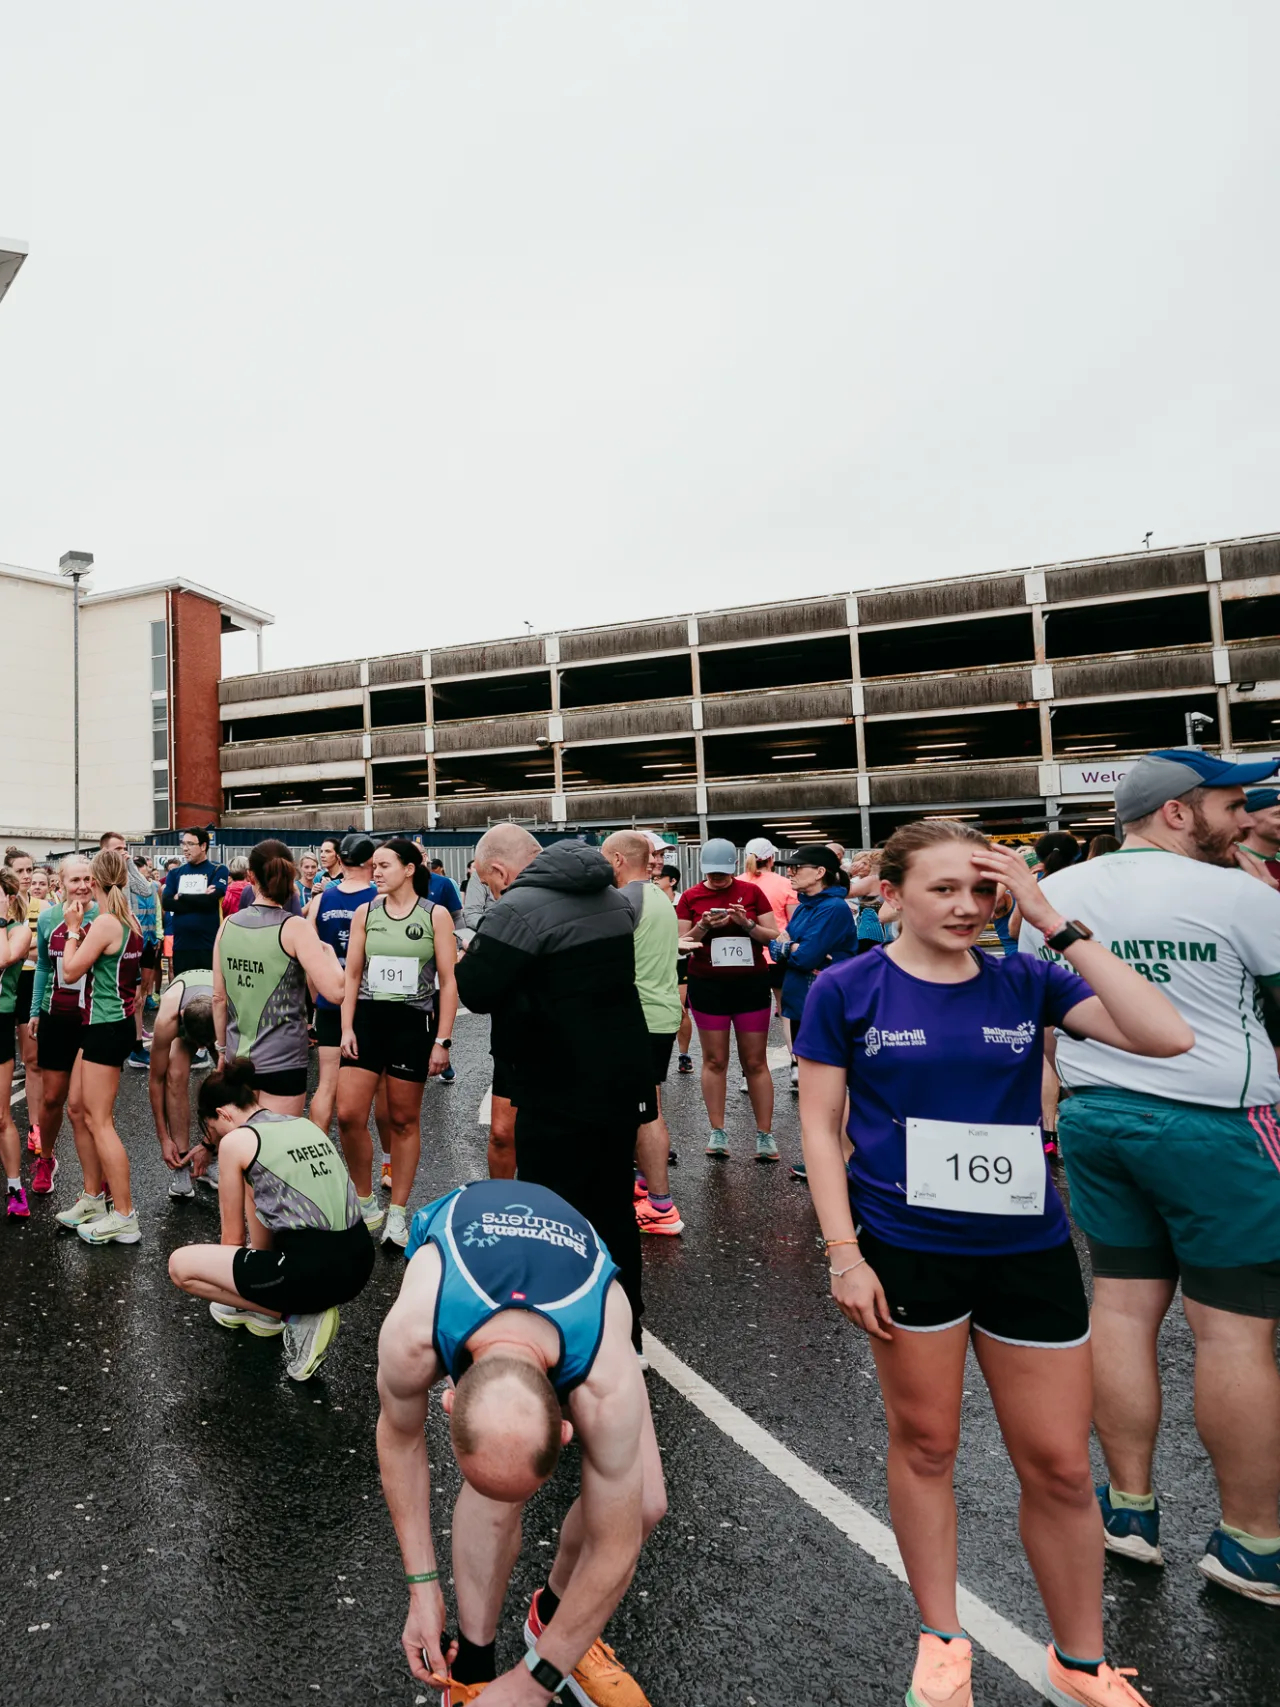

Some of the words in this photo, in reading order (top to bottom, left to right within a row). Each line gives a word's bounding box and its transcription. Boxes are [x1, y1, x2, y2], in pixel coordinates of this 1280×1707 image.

[722, 947, 743, 957] 176
[1110, 940, 1217, 962] ANTRIM
[227, 957, 264, 974] TAFELTA
[237, 975, 254, 988] A.C.
[380, 968, 403, 981] 191
[881, 1029, 926, 1041] Fairhill
[982, 1027, 1029, 1037] Ballymena
[984, 1034, 1032, 1044] runners
[968, 1129, 989, 1137] Katie
[287, 1143, 335, 1163] TAFELTA
[310, 1161, 332, 1178] A.C.
[946, 1153, 1013, 1184] 169
[482, 1212, 587, 1244] runners
[482, 1224, 588, 1259] Ballymena
